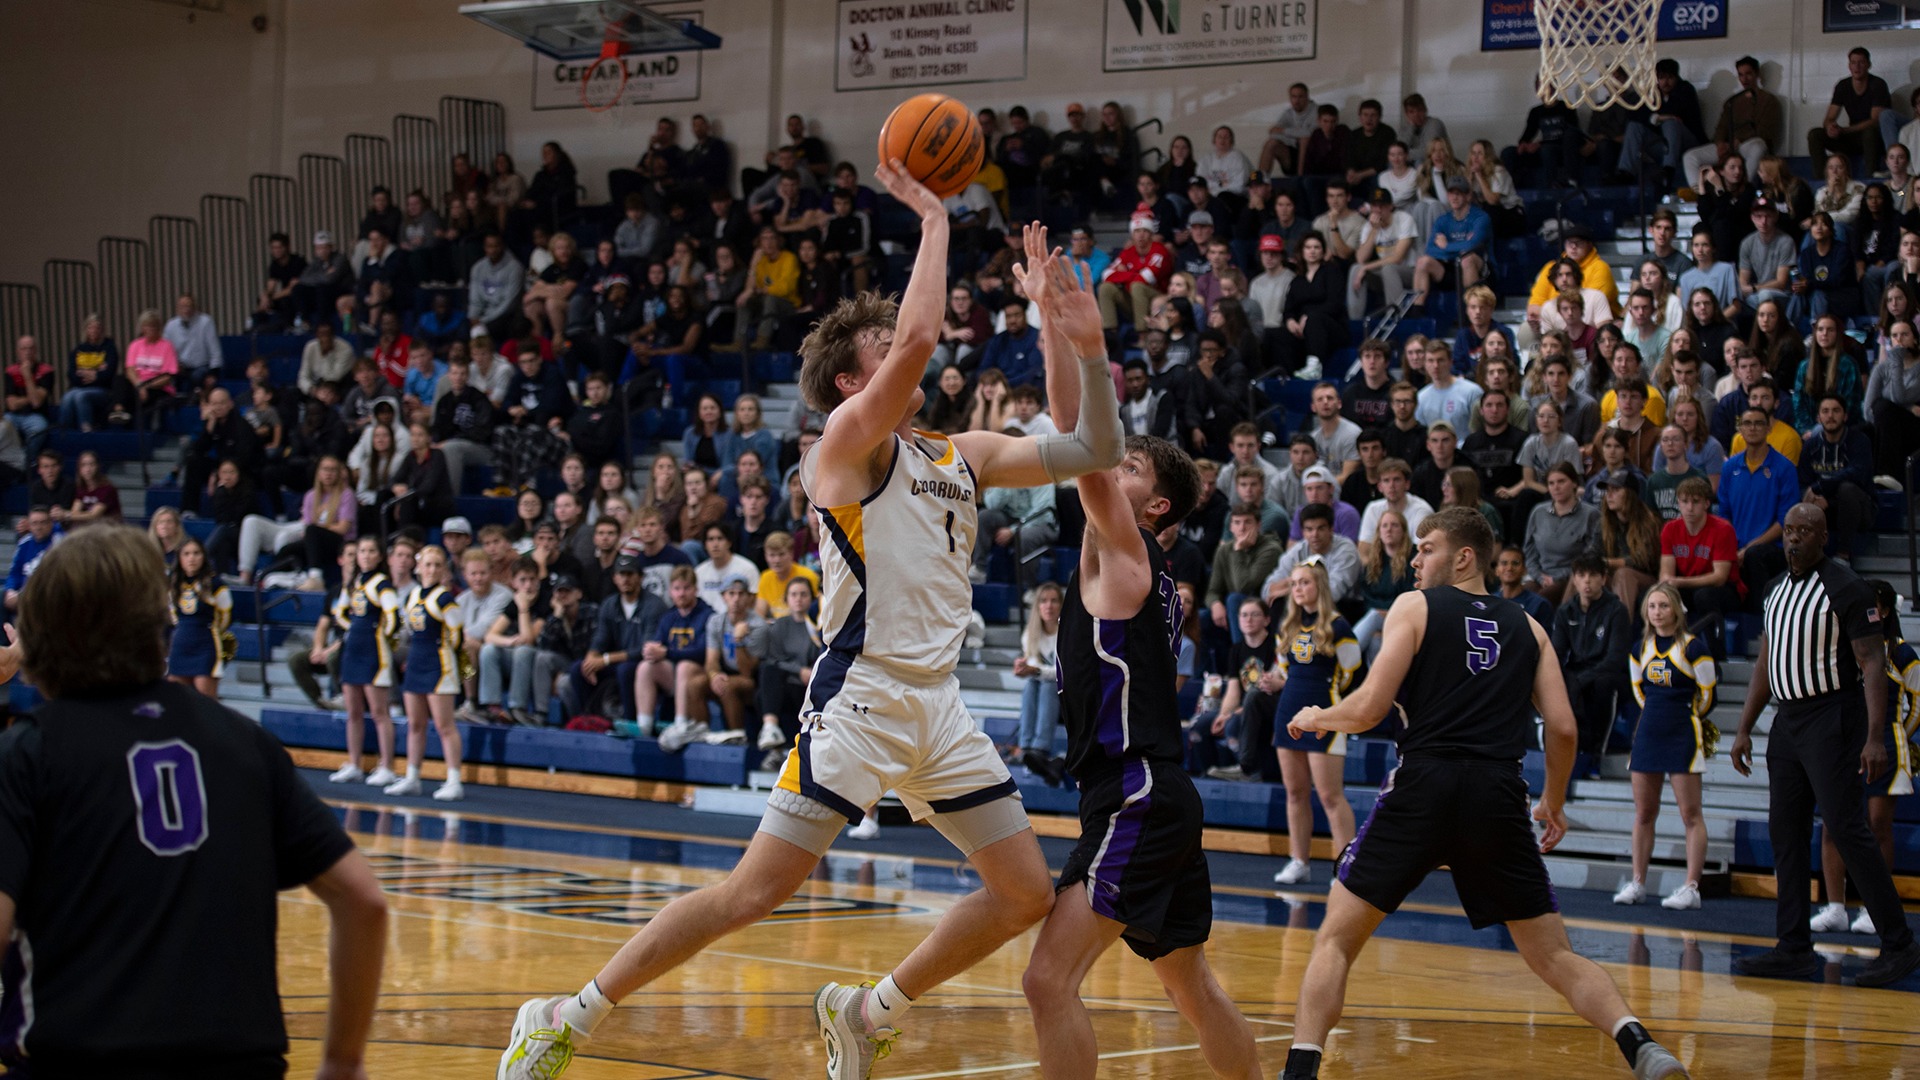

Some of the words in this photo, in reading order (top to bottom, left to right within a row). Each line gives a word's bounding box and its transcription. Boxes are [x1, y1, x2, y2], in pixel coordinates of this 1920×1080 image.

[850, 6, 905, 24] DOCTON
[909, 1, 962, 19] ANIMAL
[966, 0, 1015, 14] CLINIC
[1202, 12, 1212, 33] &
[1221, 2, 1307, 31] TURNER
[1492, 2, 1526, 16] Cheryl
[1673, 2, 1719, 30] exp
[944, 24, 971, 37] Road
[918, 45, 943, 57] Ohio
[943, 508, 957, 555] 1
[1465, 616, 1501, 675] 5
[126, 738, 209, 857] 0
